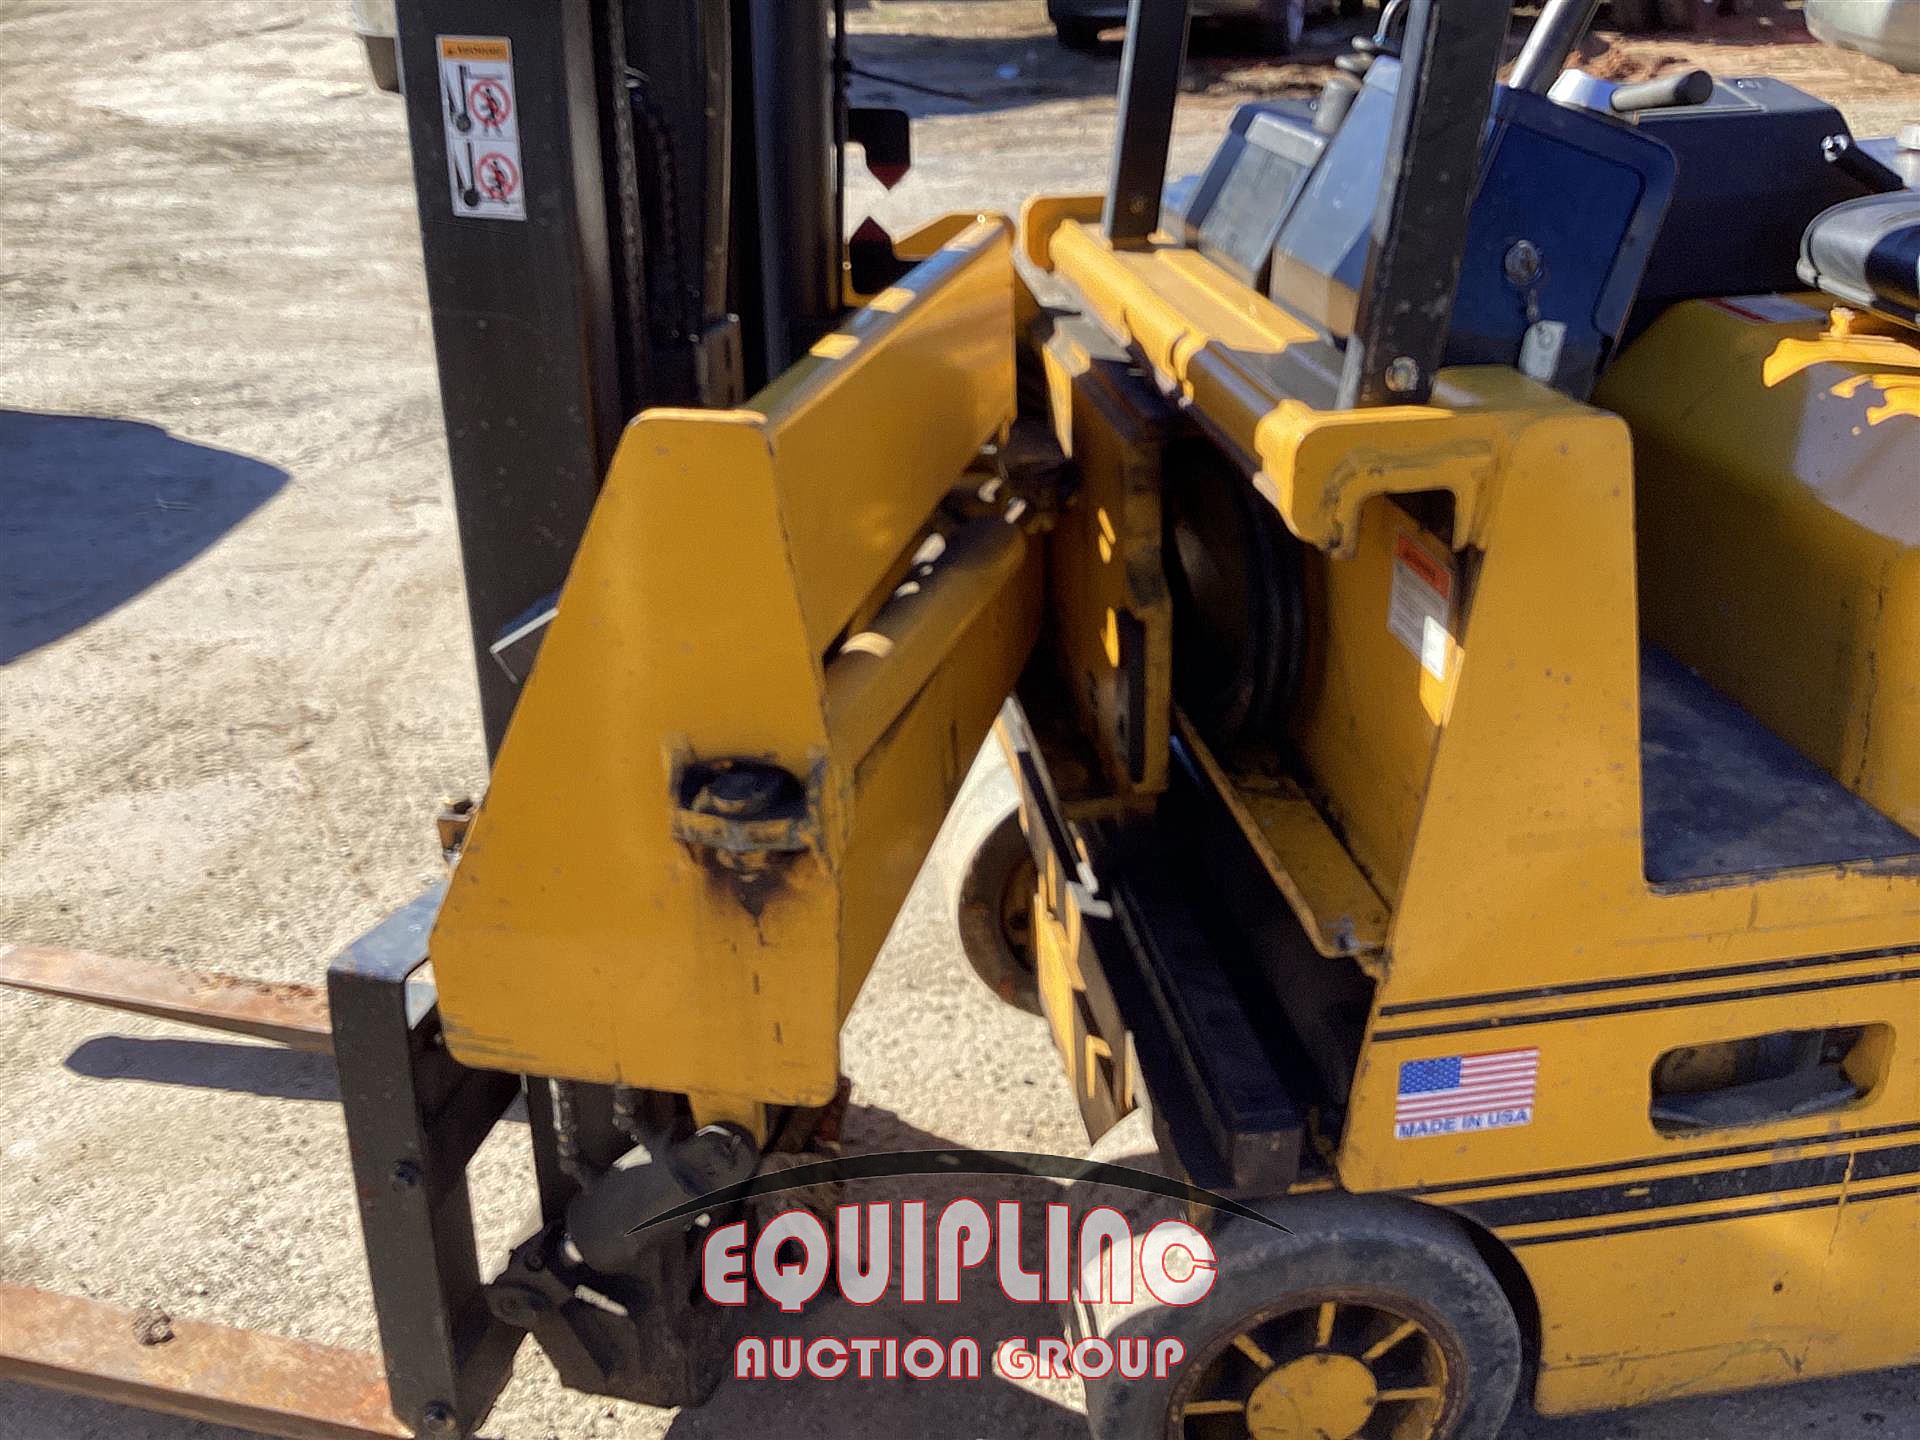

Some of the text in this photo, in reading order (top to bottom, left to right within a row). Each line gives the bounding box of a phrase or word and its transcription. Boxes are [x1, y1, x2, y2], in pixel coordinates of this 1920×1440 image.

[1399, 1110, 1528, 1137] MADE IN USA
